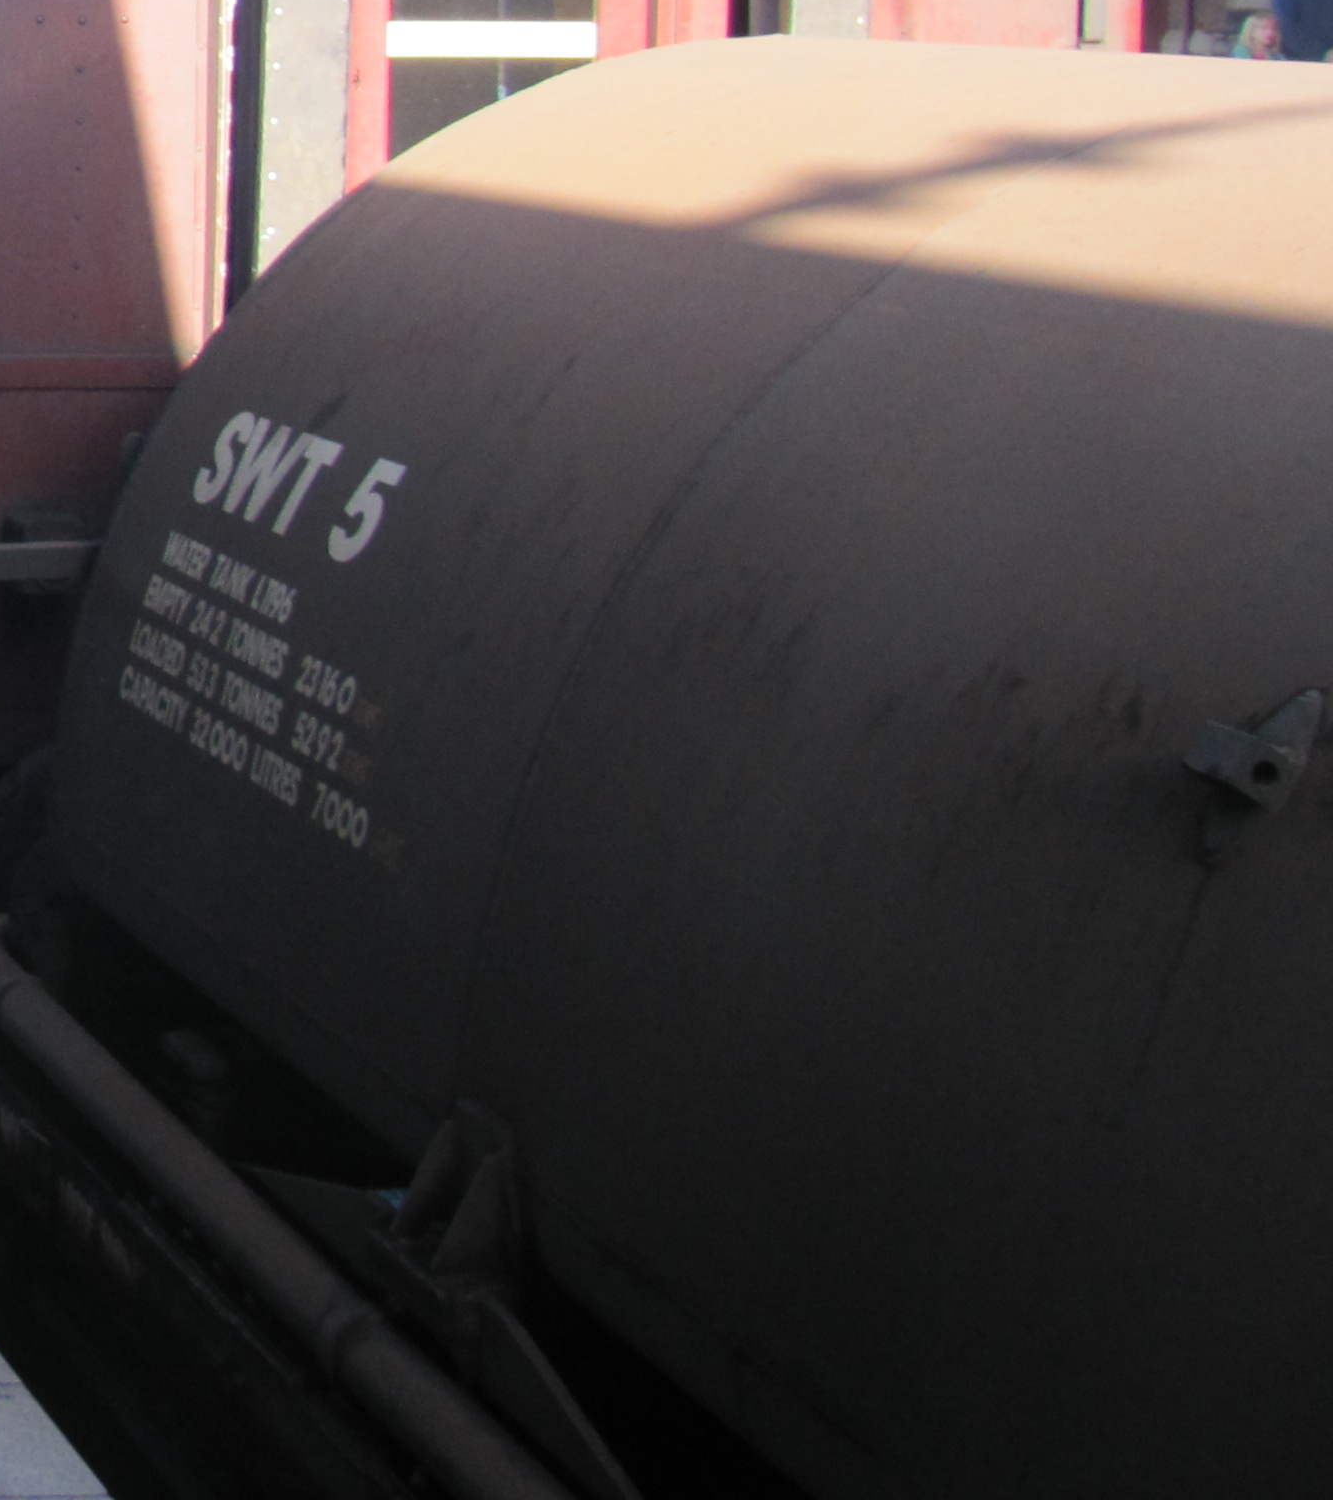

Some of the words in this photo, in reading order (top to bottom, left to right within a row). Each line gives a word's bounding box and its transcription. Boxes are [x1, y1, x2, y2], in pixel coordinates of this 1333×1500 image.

[193, 411, 344, 536] SWT
[328, 457, 408, 563] 5
[162, 530, 213, 582] WATER
[208, 553, 257, 604] TANK
[130, 618, 187, 678] LOADED
[220, 670, 284, 736] TONNES
[142, 572, 193, 626] EMPTY
[225, 617, 290, 681] TONNES
[120, 664, 190, 734] CAPACITY
[250, 743, 303, 807] LITRES
[311, 780, 369, 849] 7000
